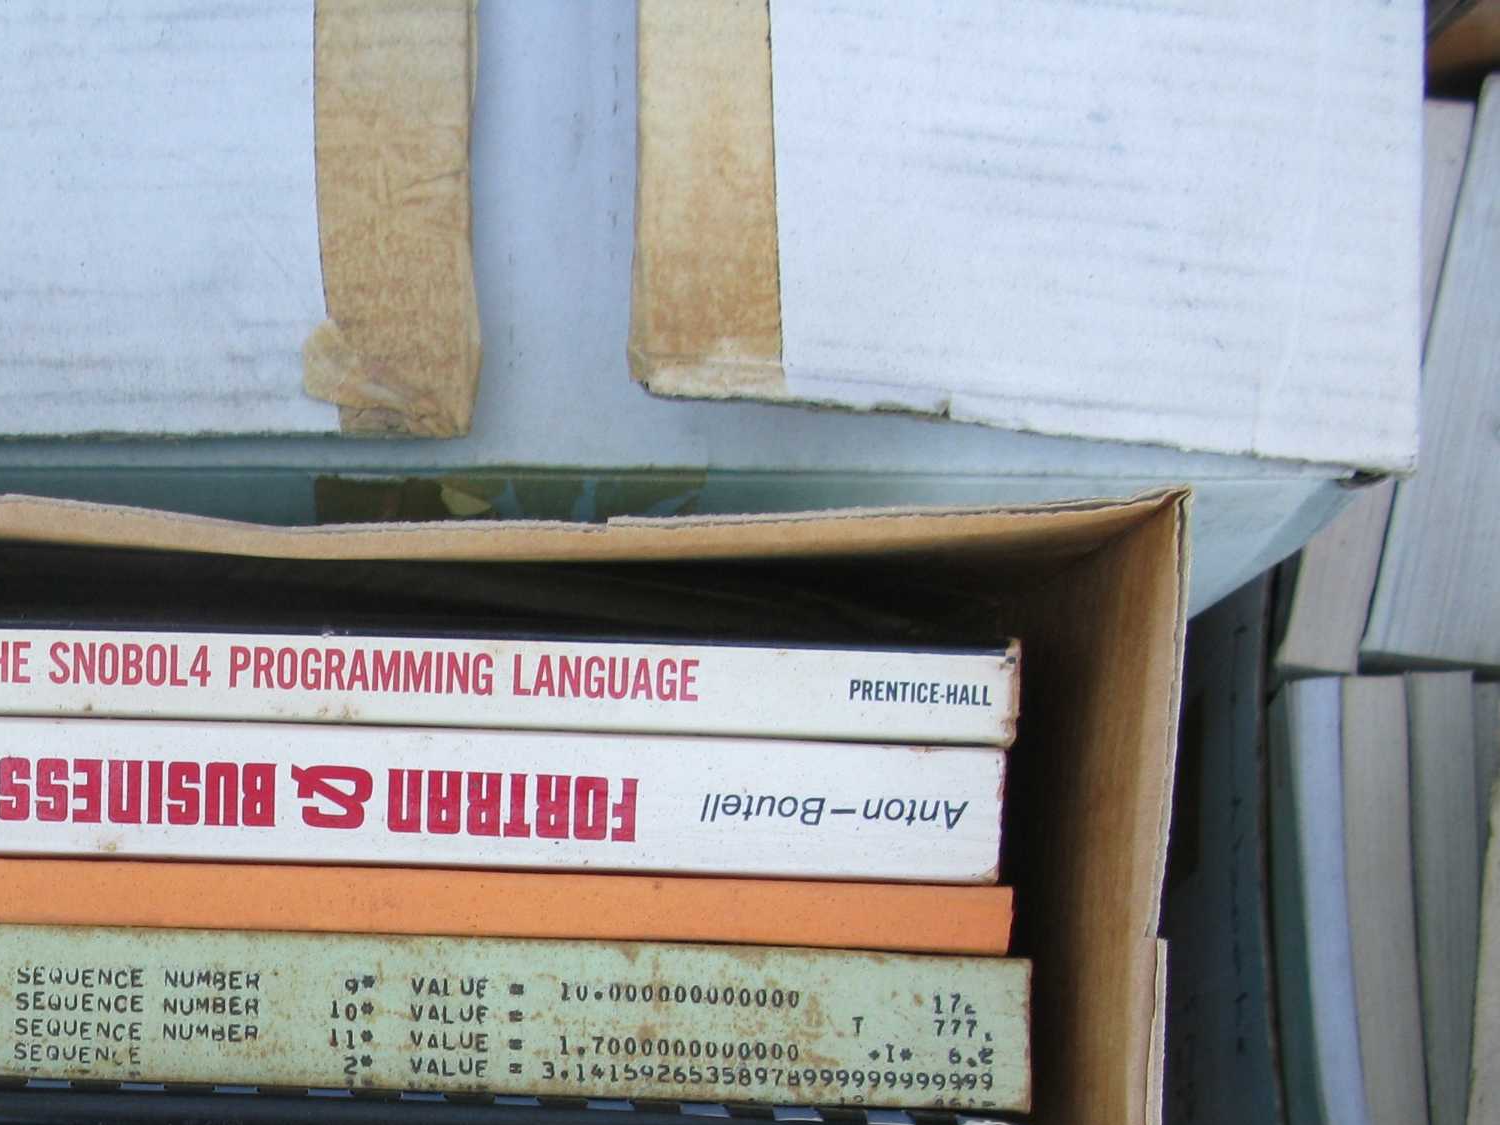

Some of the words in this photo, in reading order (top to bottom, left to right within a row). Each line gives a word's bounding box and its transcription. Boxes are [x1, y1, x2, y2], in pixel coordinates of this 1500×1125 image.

[47, 640, 211, 688] SNOBOL4
[228, 646, 495, 696] PROGRAMMING
[511, 653, 700, 703] LANGUAGE
[847, 679, 993, 707] PRENTICE-HALL
[290, 762, 374, 830] &
[386, 767, 640, 843] FORTRAN
[16, 966, 145, 989] SEQUENCE
[163, 969, 261, 992] NUMBER
[410, 976, 490, 1000] VALUE
[15, 992, 145, 1013] SEQUENCE
[163, 995, 260, 1016] NUMBER
[410, 1003, 490, 1025] VALUE
[13, 1016, 142, 1042] SEQUENCE
[162, 1022, 260, 1043] NUMBER
[409, 1030, 490, 1053] VALUE
[13, 1042, 142, 1067] SEQUENCE
[409, 1055, 489, 1078] VALUE
